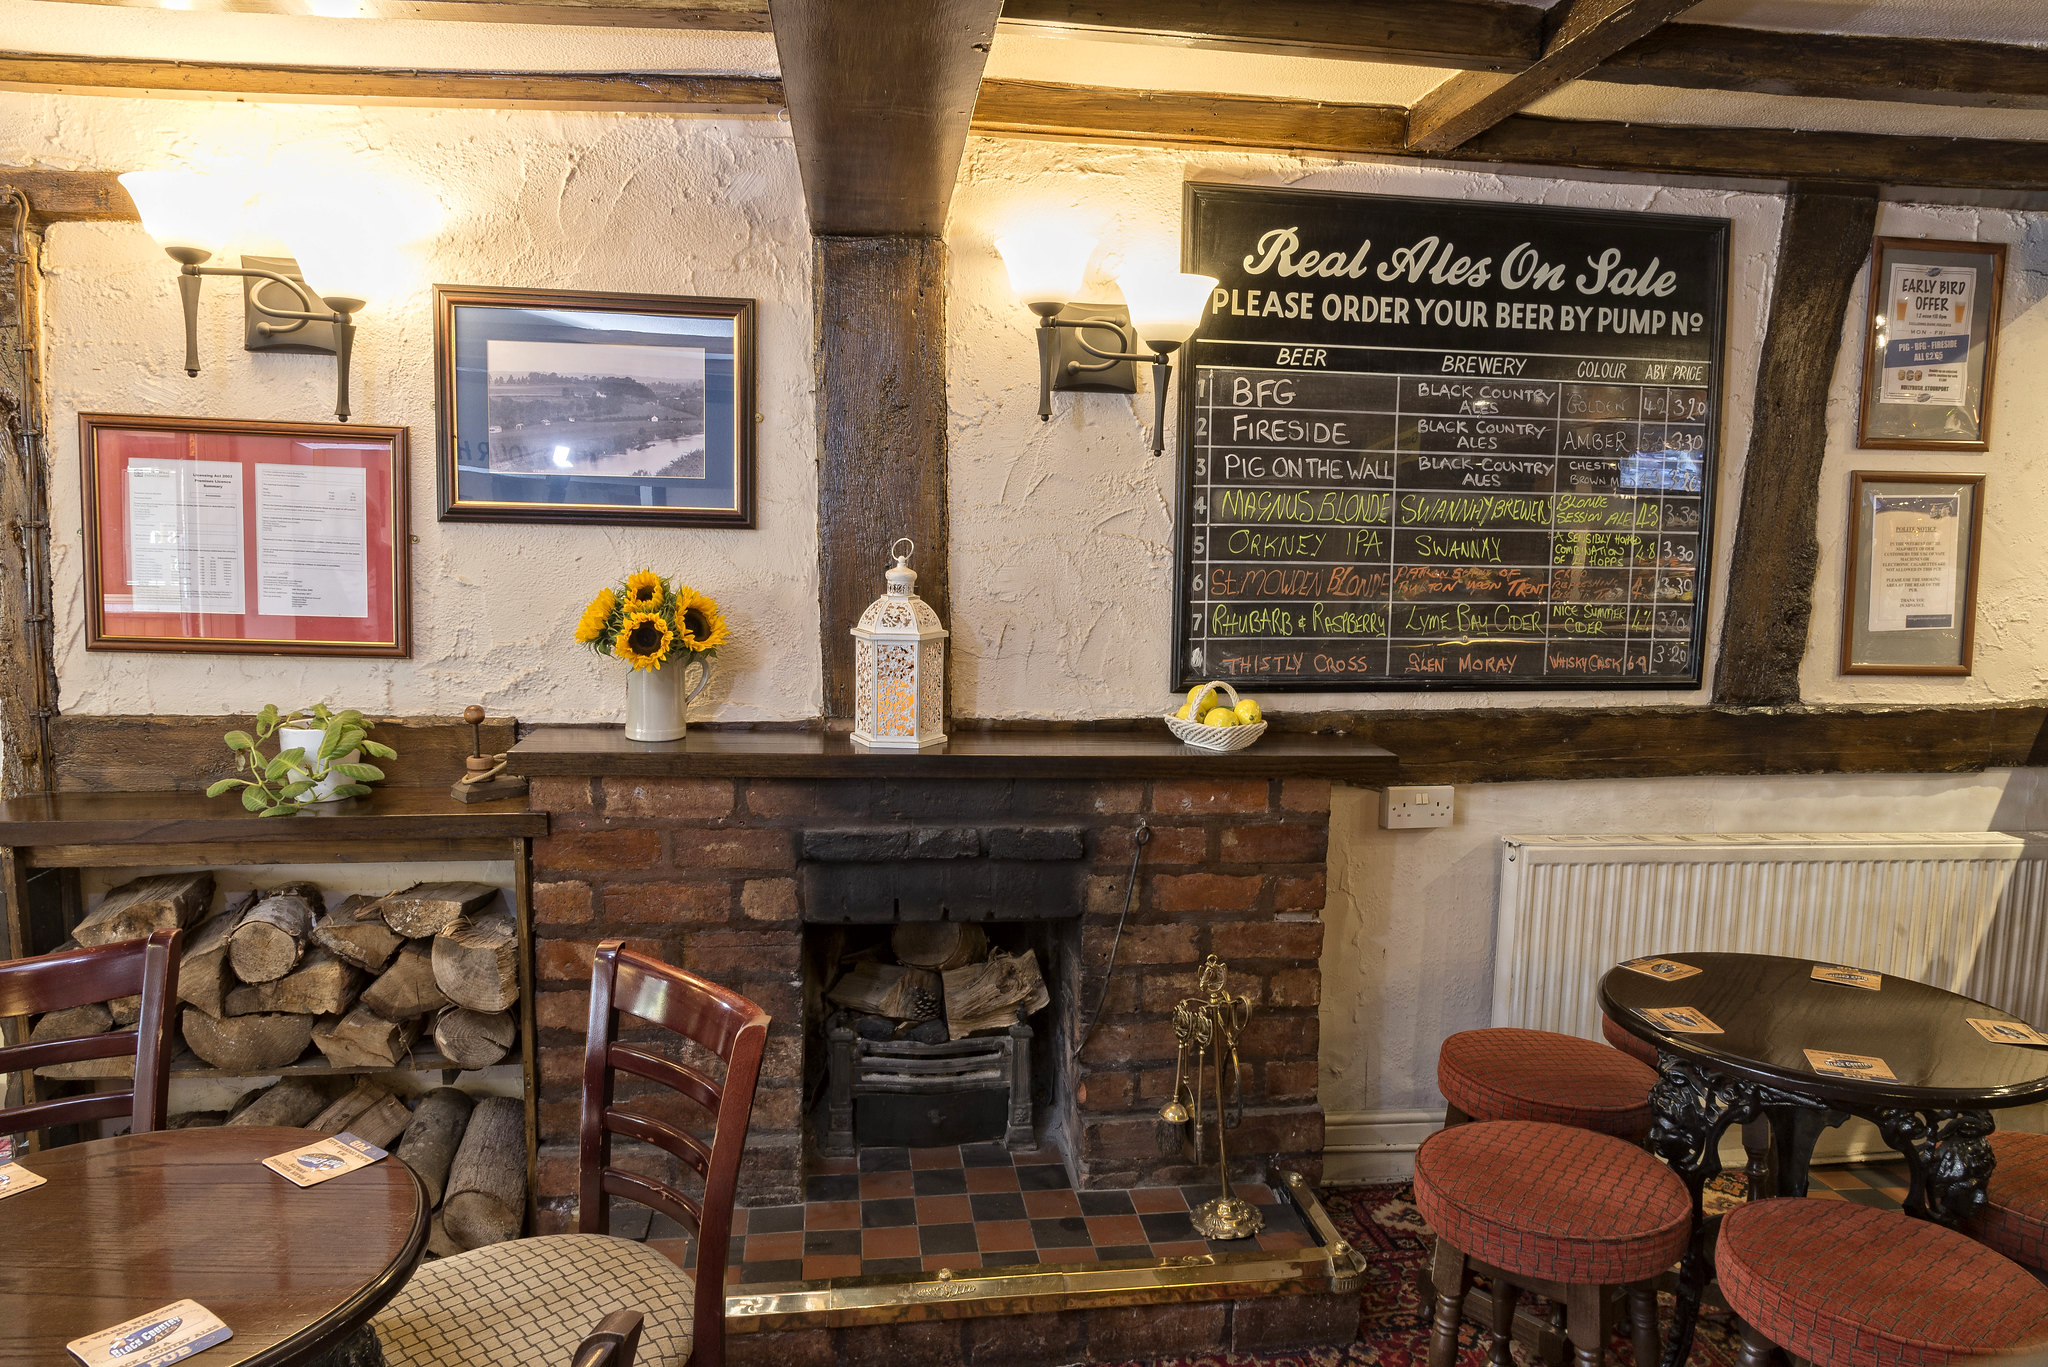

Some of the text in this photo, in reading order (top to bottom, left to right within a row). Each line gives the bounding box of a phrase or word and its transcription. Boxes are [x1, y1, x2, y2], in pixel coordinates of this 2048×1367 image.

[1243, 226, 1677, 297] Real Ales On Sale
[1902, 278, 1966, 296] EARLY BIRD
[1212, 288, 1313, 320] PLEASE
[1321, 294, 1409, 324] ORDER
[1414, 297, 1488, 328] YOUR
[1495, 302, 1554, 330] BEER
[1559, 305, 1594, 332] BY
[1598, 307, 1666, 335] PUMP
[1915, 296, 1949, 311] OFFER
[1276, 347, 1703, 381] BEER BREWERY COLOUR ABV PRICE
[1913, 352, 1924, 361] ALL
[1198, 379, 1205, 397] 1
[1232, 376, 1296, 407] BFG
[1418, 383, 1556, 405] BLACK COUNTRY
[1459, 400, 1499, 415] ALES
[1566, 392, 1631, 414] GOLDEN
[1196, 418, 1207, 436] 2
[1233, 414, 1351, 445] FIRESIDE
[1417, 419, 1547, 439] BLACK COUNTRY
[1457, 435, 1497, 450] ALES
[1563, 430, 1630, 452] AMBER
[1195, 458, 1206, 476] 3
[1225, 454, 1265, 479] PIG
[1272, 457, 1303, 478] ON
[1346, 457, 1395, 480] WALL
[1418, 456, 1555, 476] BLACK COUNTRY
[1462, 473, 1501, 487] ALES
[1570, 474, 1606, 485] BROWN
[1194, 496, 1207, 514] 4
[1221, 489, 1390, 524] MAGNUS BLONDE
[1491, 496, 1554, 525] BREWERY
[1604, 511, 1633, 526] ALE
[1193, 536, 1204, 554] 5
[1228, 529, 1383, 557] ORKNEY IPA
[1415, 534, 1501, 563] SWANNAY
[1635, 541, 1656, 561] 4.8
[1663, 541, 1694, 562] 3.30
[1553, 556, 1565, 564] OF
[1192, 574, 1204, 591] 6
[1326, 566, 1391, 598] BLONDE
[1499, 568, 1521, 580] OF
[1661, 577, 1692, 596] 3.30
[1192, 613, 1202, 631] 7
[1212, 604, 1293, 636] RHUBARB
[1312, 601, 1386, 638] RASPBERRY
[1406, 602, 1545, 636] LYME BAY CIDER
[1553, 604, 1626, 620] NICE SUMMER
[1564, 618, 1608, 635] CIDER
[1223, 652, 1303, 675] THISTLY
[1313, 654, 1368, 673] CROSS
[1408, 653, 1517, 673] GLEN MORAY
[1549, 654, 1623, 672] WHISKY CASK
[348, 1139, 372, 1152] PUB
[131, 1303, 184, 1325] WELCOME
[110, 1316, 181, 1358] BLACK COUNTRY
[142, 1324, 220, 1360] COUNTRY ALES
[154, 1324, 179, 1342] ALES
[147, 1346, 193, 1367] PUB
